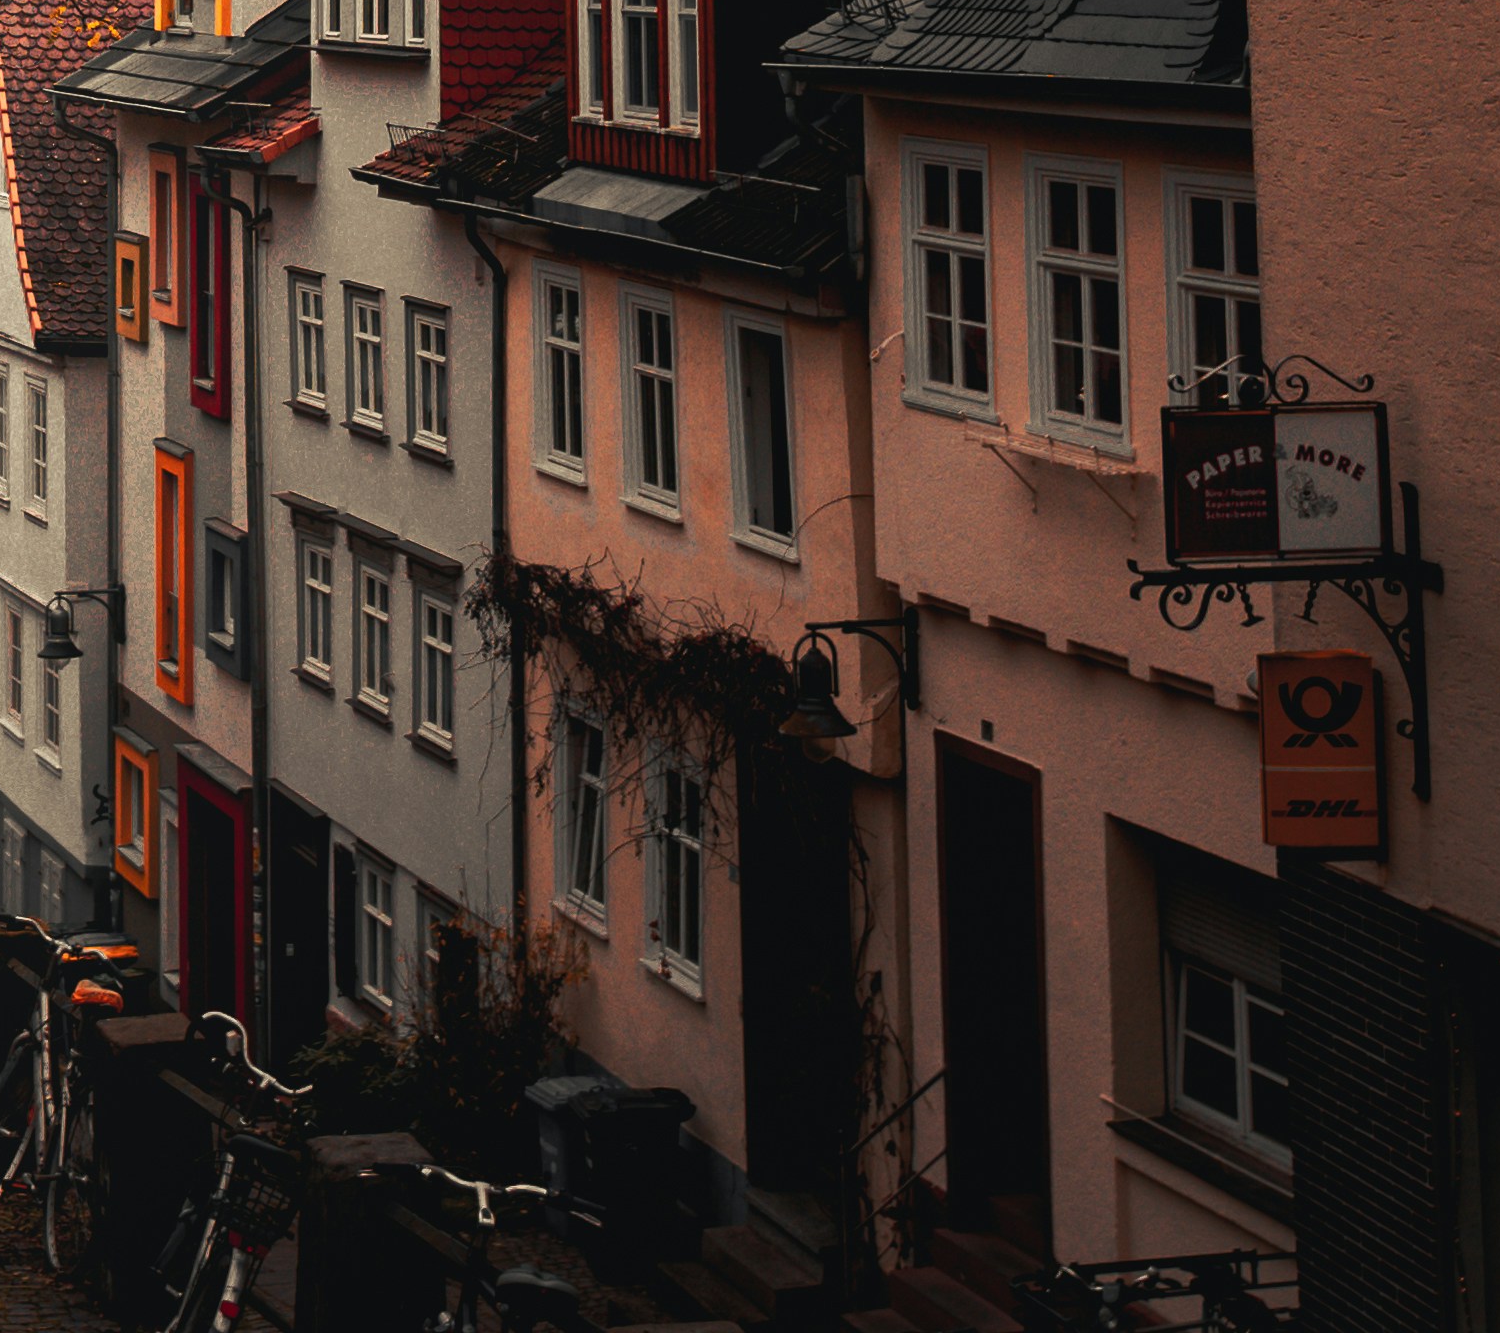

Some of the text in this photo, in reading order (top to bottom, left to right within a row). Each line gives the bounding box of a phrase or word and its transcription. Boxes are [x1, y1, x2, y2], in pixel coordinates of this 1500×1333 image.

[1185, 443, 1366, 490] PAPER & MORE
[1205, 500, 1267, 509] Kopierservice
[1205, 510, 1267, 520] Schreibwaren
[1286, 799, 1363, 818] DHL
